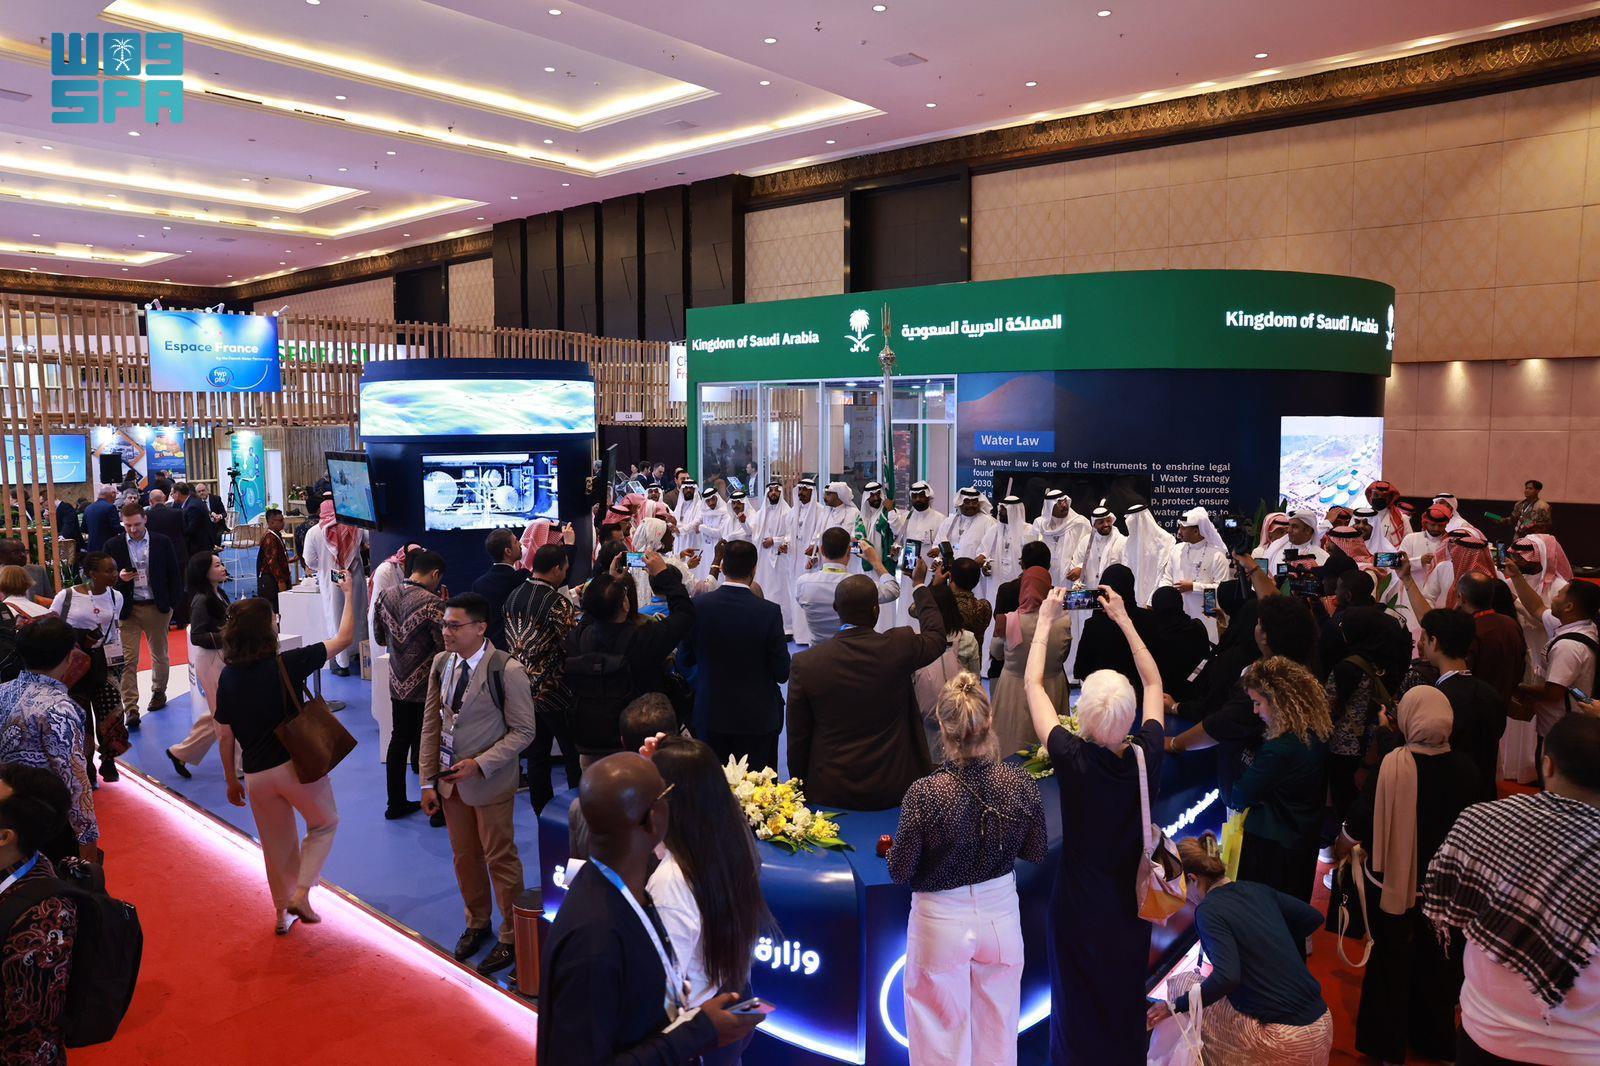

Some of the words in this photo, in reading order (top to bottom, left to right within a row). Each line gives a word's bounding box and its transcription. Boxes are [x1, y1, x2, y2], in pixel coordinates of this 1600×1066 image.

[961, 317, 1003, 338] العربية
[1005, 314, 1062, 332] المملكة
[1225, 310, 1297, 330] Kingdom
[1300, 312, 1314, 329] of
[1316, 314, 1349, 331] Saudi
[1351, 316, 1379, 334] Arabia
[901, 320, 959, 341] السعودية
[164, 340, 212, 354] Espace
[214, 341, 259, 354] France
[692, 337, 735, 353] Kingdom
[736, 335, 748, 348] of
[749, 333, 780, 348] Saudi
[782, 330, 820, 346] Arabia
[981, 434, 1014, 446] Water
[1016, 435, 1039, 446] Law
[973, 458, 987, 466] The
[989, 459, 1012, 467] water
[1014, 459, 1029, 467] law
[1032, 460, 1039, 468] is
[1060, 460, 1070, 468] of
[1074, 460, 1089, 469] the
[1092, 461, 1148, 470] instruments
[1152, 462, 1162, 470] to
[1165, 462, 1205, 471] enshrine
[1209, 462, 1231, 473] legal
[972, 479, 994, 488] 2030,
[1154, 485, 1166, 493] all
[1168, 486, 1194, 494] water
[1160, 474, 1188, 482] Water
[1193, 474, 1230, 484] Strategy
[1161, 497, 1197, 506] protect,
[1199, 498, 1230, 506] ensure
[1153, 508, 1179, 516] water
[1164, 519, 1174, 528] of
[754, 936, 820, 975] وزارة
